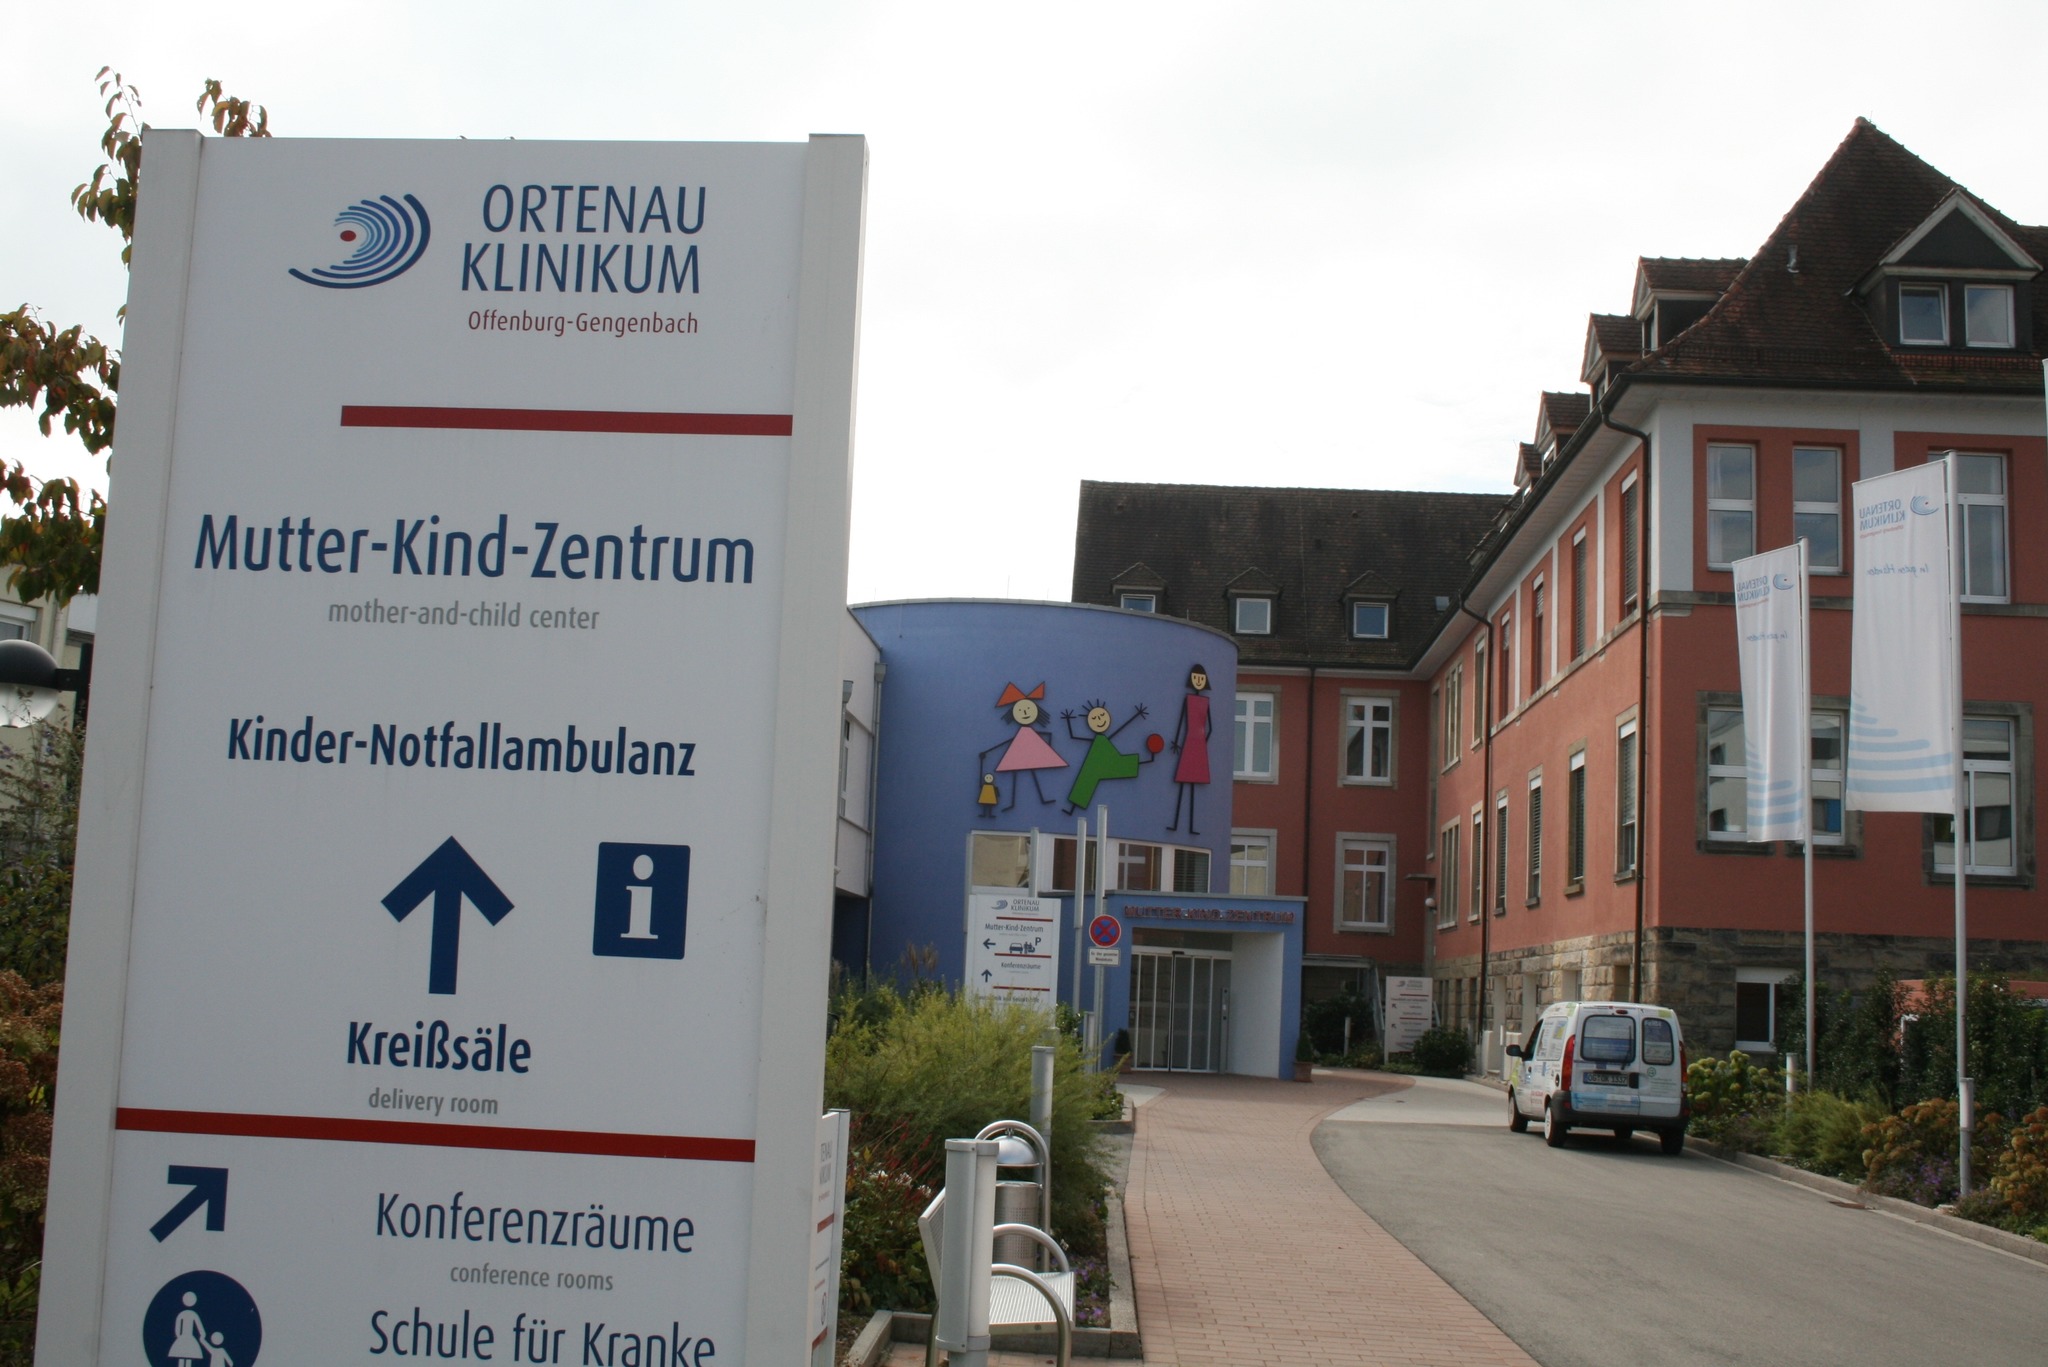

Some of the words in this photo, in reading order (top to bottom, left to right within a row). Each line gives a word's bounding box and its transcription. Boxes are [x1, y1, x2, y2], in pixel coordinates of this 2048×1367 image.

[482, 183, 707, 235] ORTENAU
[461, 242, 700, 295] KLINIKUM
[467, 308, 698, 339] Offenburg-Gengenbach
[193, 513, 755, 585] Mutter-Kind-Zentrum
[328, 597, 521, 628] mother-and-child
[529, 606, 600, 630] center
[227, 714, 697, 777] Kinder-Notfallambulanz
[984, 923, 1044, 933] Mutter-Kind-Zentrum
[1035, 937, 1042, 946] P
[346, 1019, 532, 1074] Kreißsäle
[368, 1086, 445, 1117] delivery
[450, 1096, 499, 1115] room
[376, 1190, 695, 1254] Konferenzräume
[450, 1262, 550, 1289] conference
[557, 1272, 614, 1292] rooms
[369, 1307, 495, 1361] Schule
[512, 1312, 567, 1365] für
[582, 1320, 716, 1367] Kranke
